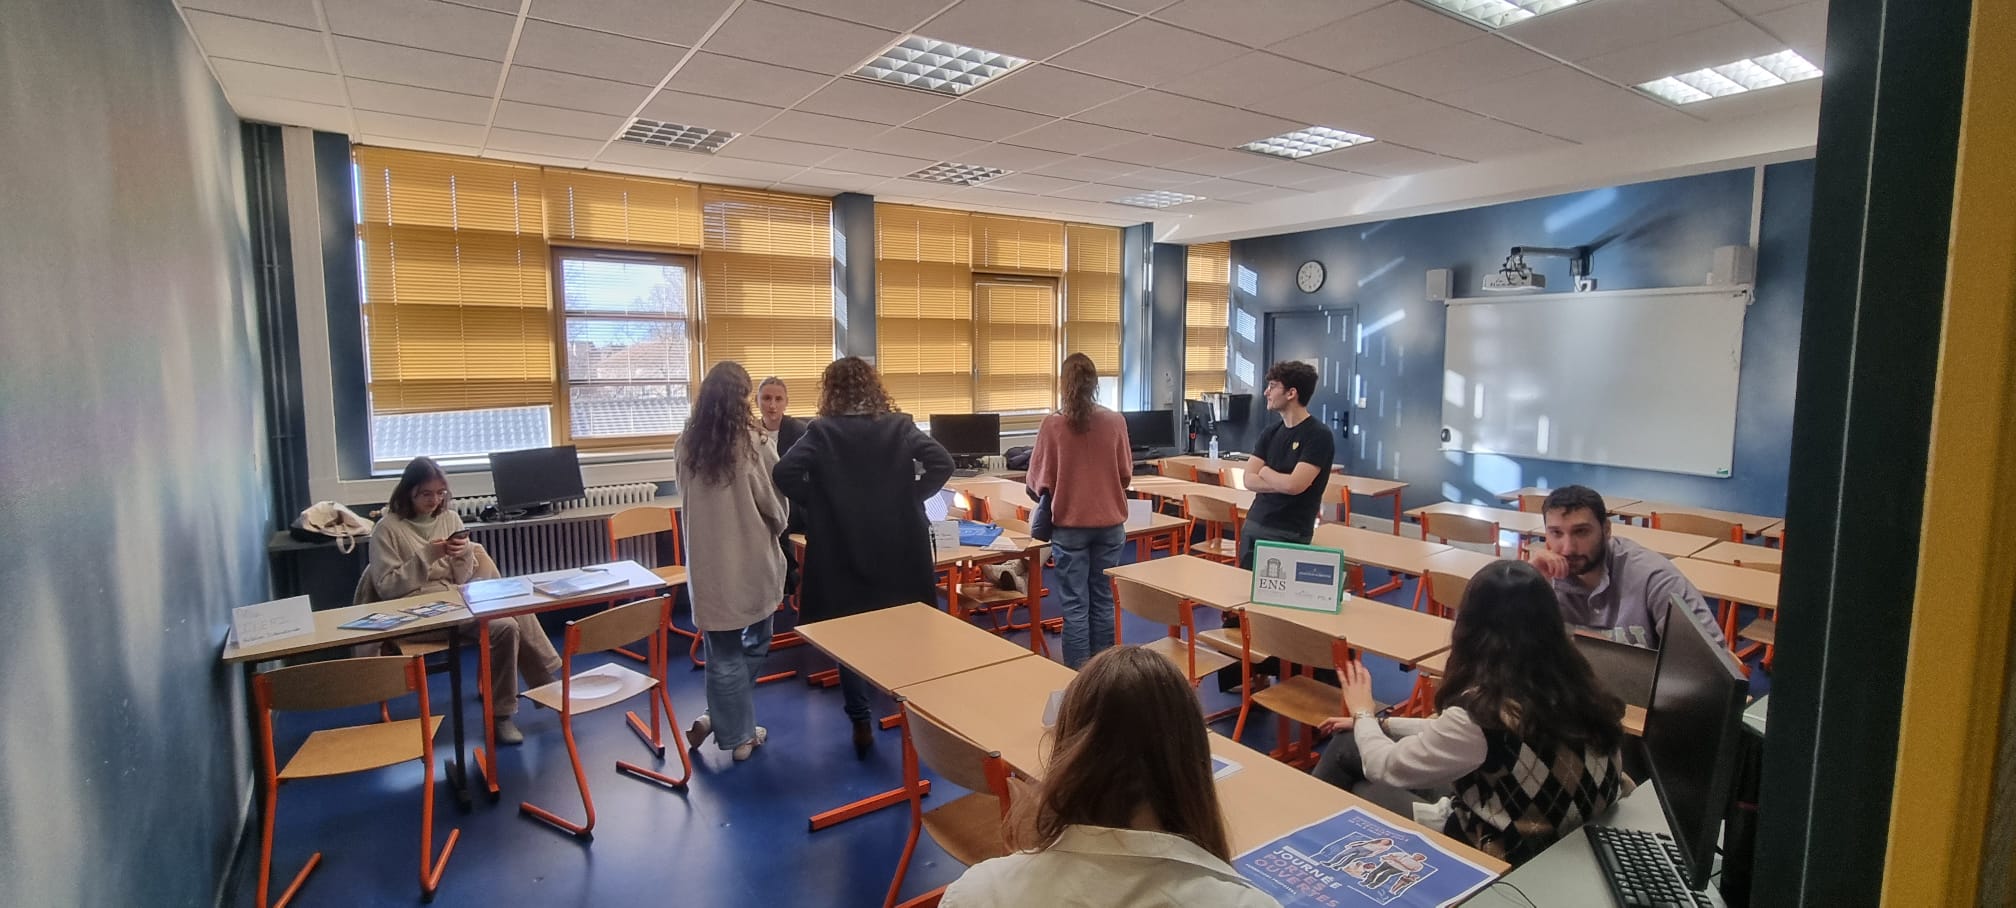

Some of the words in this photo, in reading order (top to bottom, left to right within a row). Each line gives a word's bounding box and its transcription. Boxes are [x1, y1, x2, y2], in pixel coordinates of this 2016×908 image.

[1259, 578, 1286, 591] ENS
[1254, 859, 1339, 907] OUVERTES
[1263, 853, 1326, 892] PORTES
[1273, 849, 1342, 889] JOURNÉE
